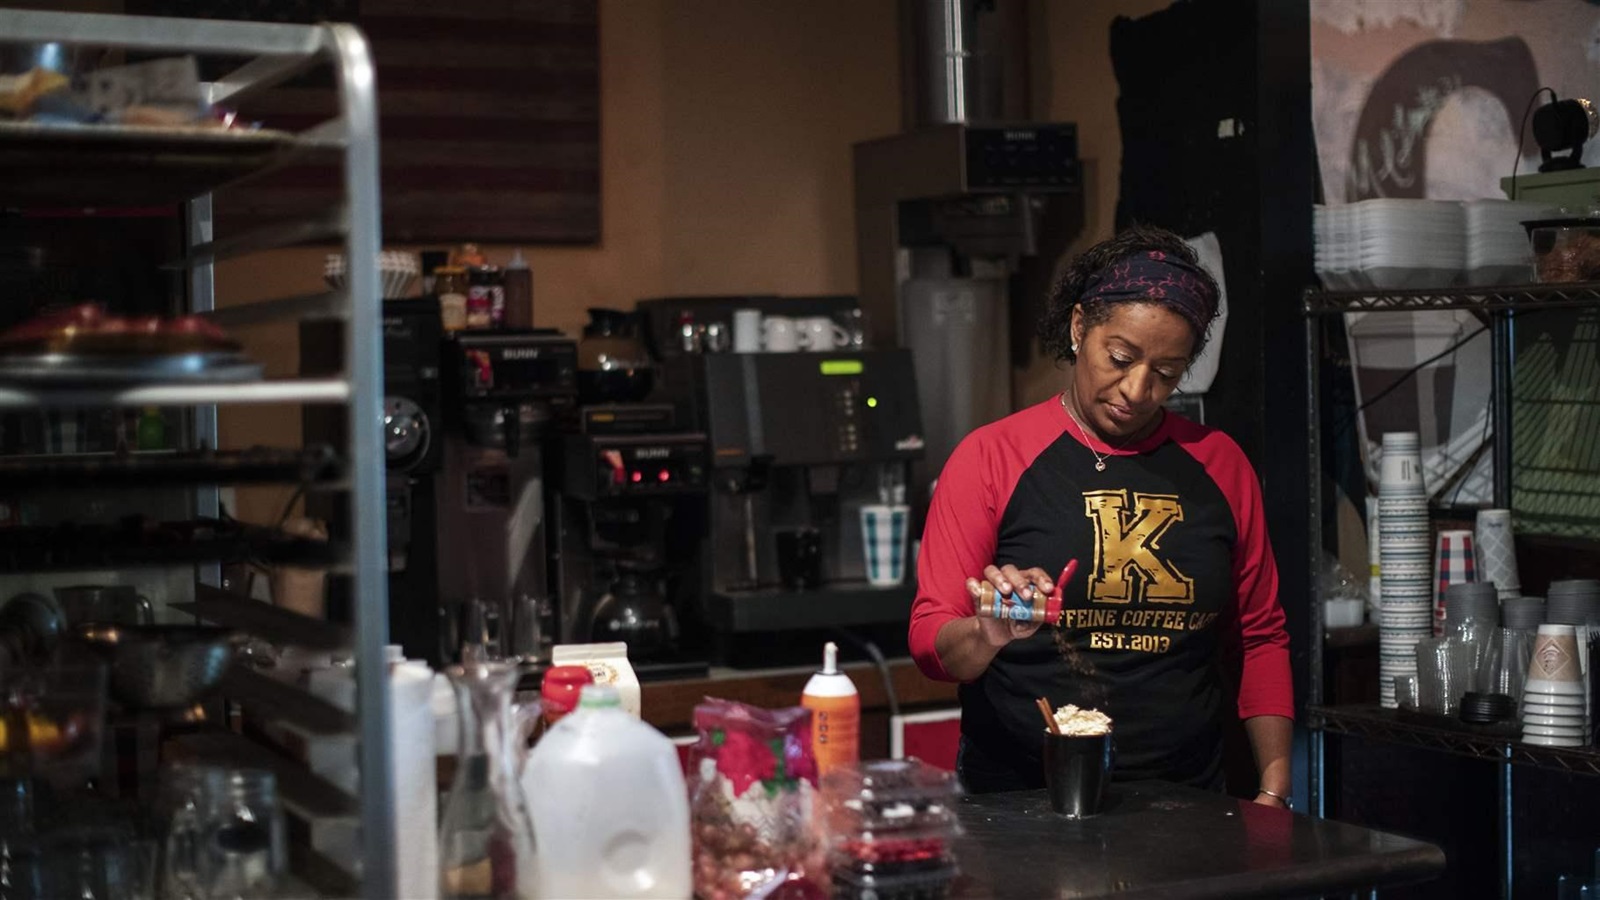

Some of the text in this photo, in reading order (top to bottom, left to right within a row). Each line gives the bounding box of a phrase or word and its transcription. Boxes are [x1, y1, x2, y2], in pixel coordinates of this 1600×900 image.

[1082, 489, 1195, 604] K
[1056, 609, 1117, 628] FFEINE
[1121, 609, 1186, 631] COFFEE
[1090, 631, 1171, 653] EST.2013
